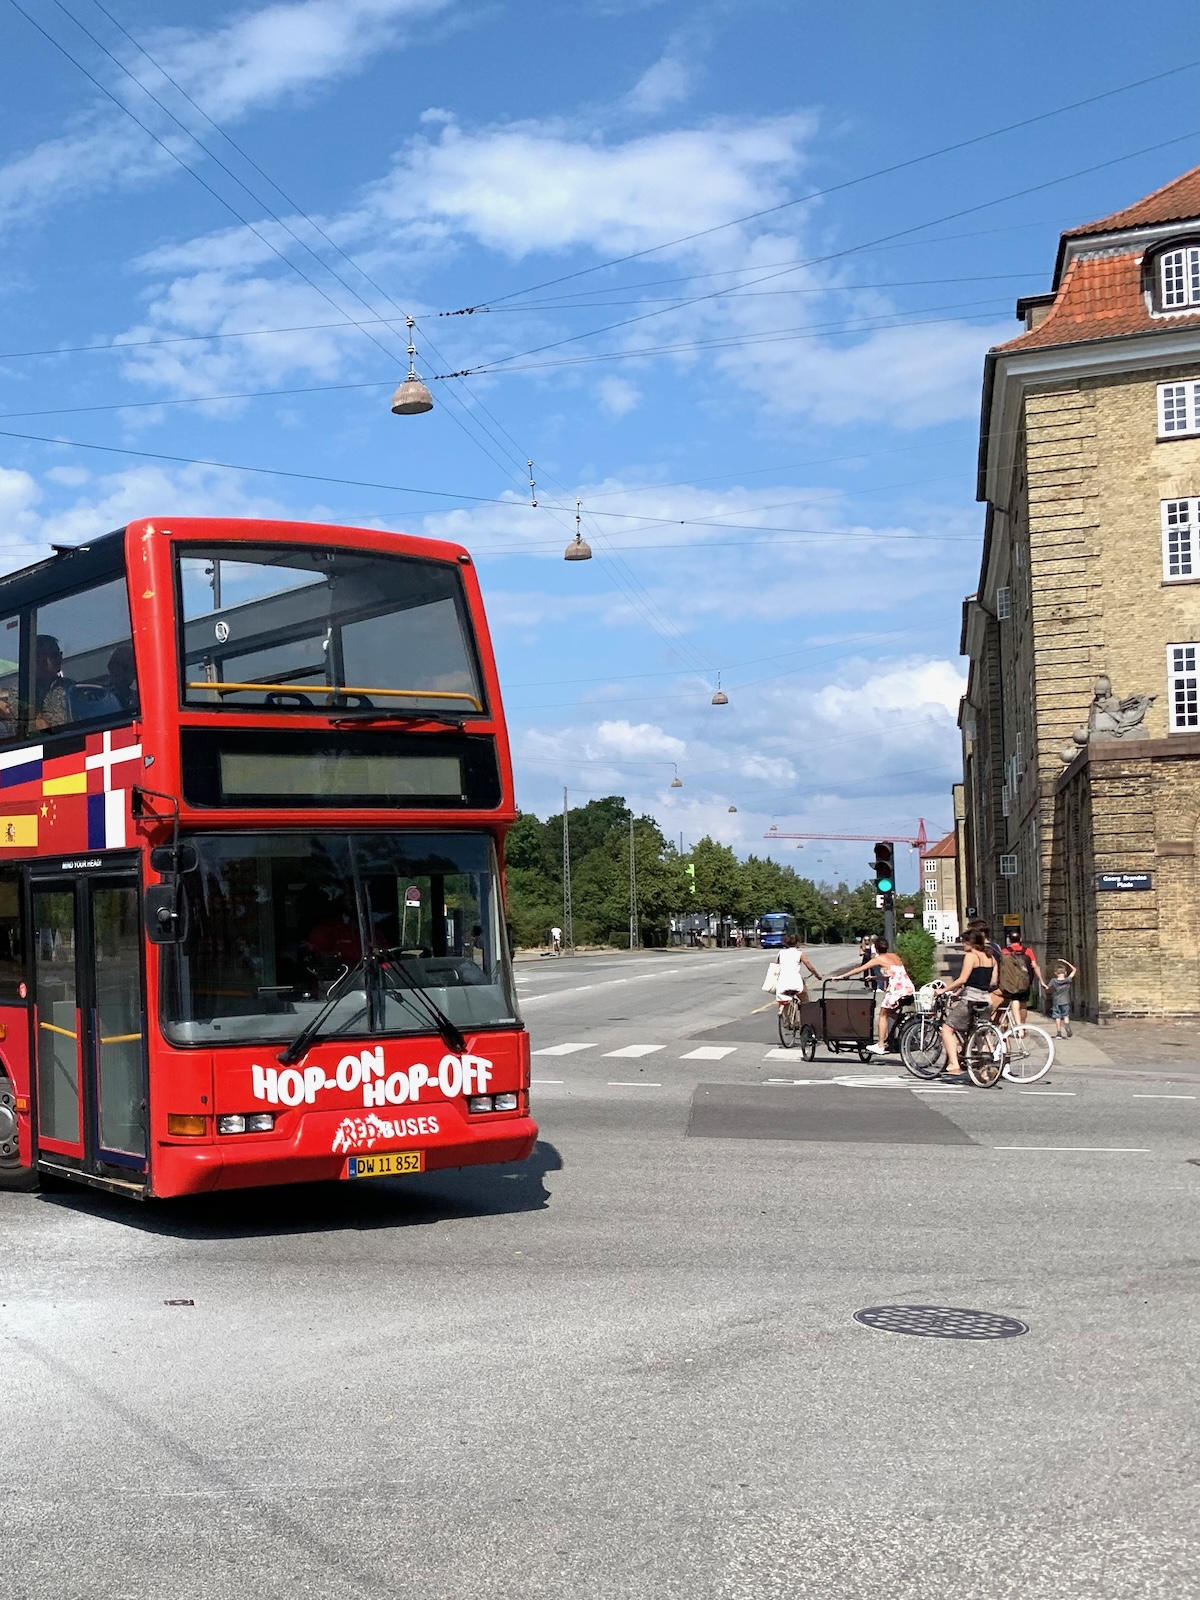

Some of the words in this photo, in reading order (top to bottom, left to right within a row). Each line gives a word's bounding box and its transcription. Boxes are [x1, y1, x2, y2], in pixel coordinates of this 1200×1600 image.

[252, 1046, 385, 1107] HOP-ON
[363, 1054, 493, 1108] HOP-OFF
[383, 1115, 440, 1139] BUSES
[357, 1158, 375, 1174] DW
[379, 1157, 392, 1172] 11
[395, 1155, 419, 1171] 852
